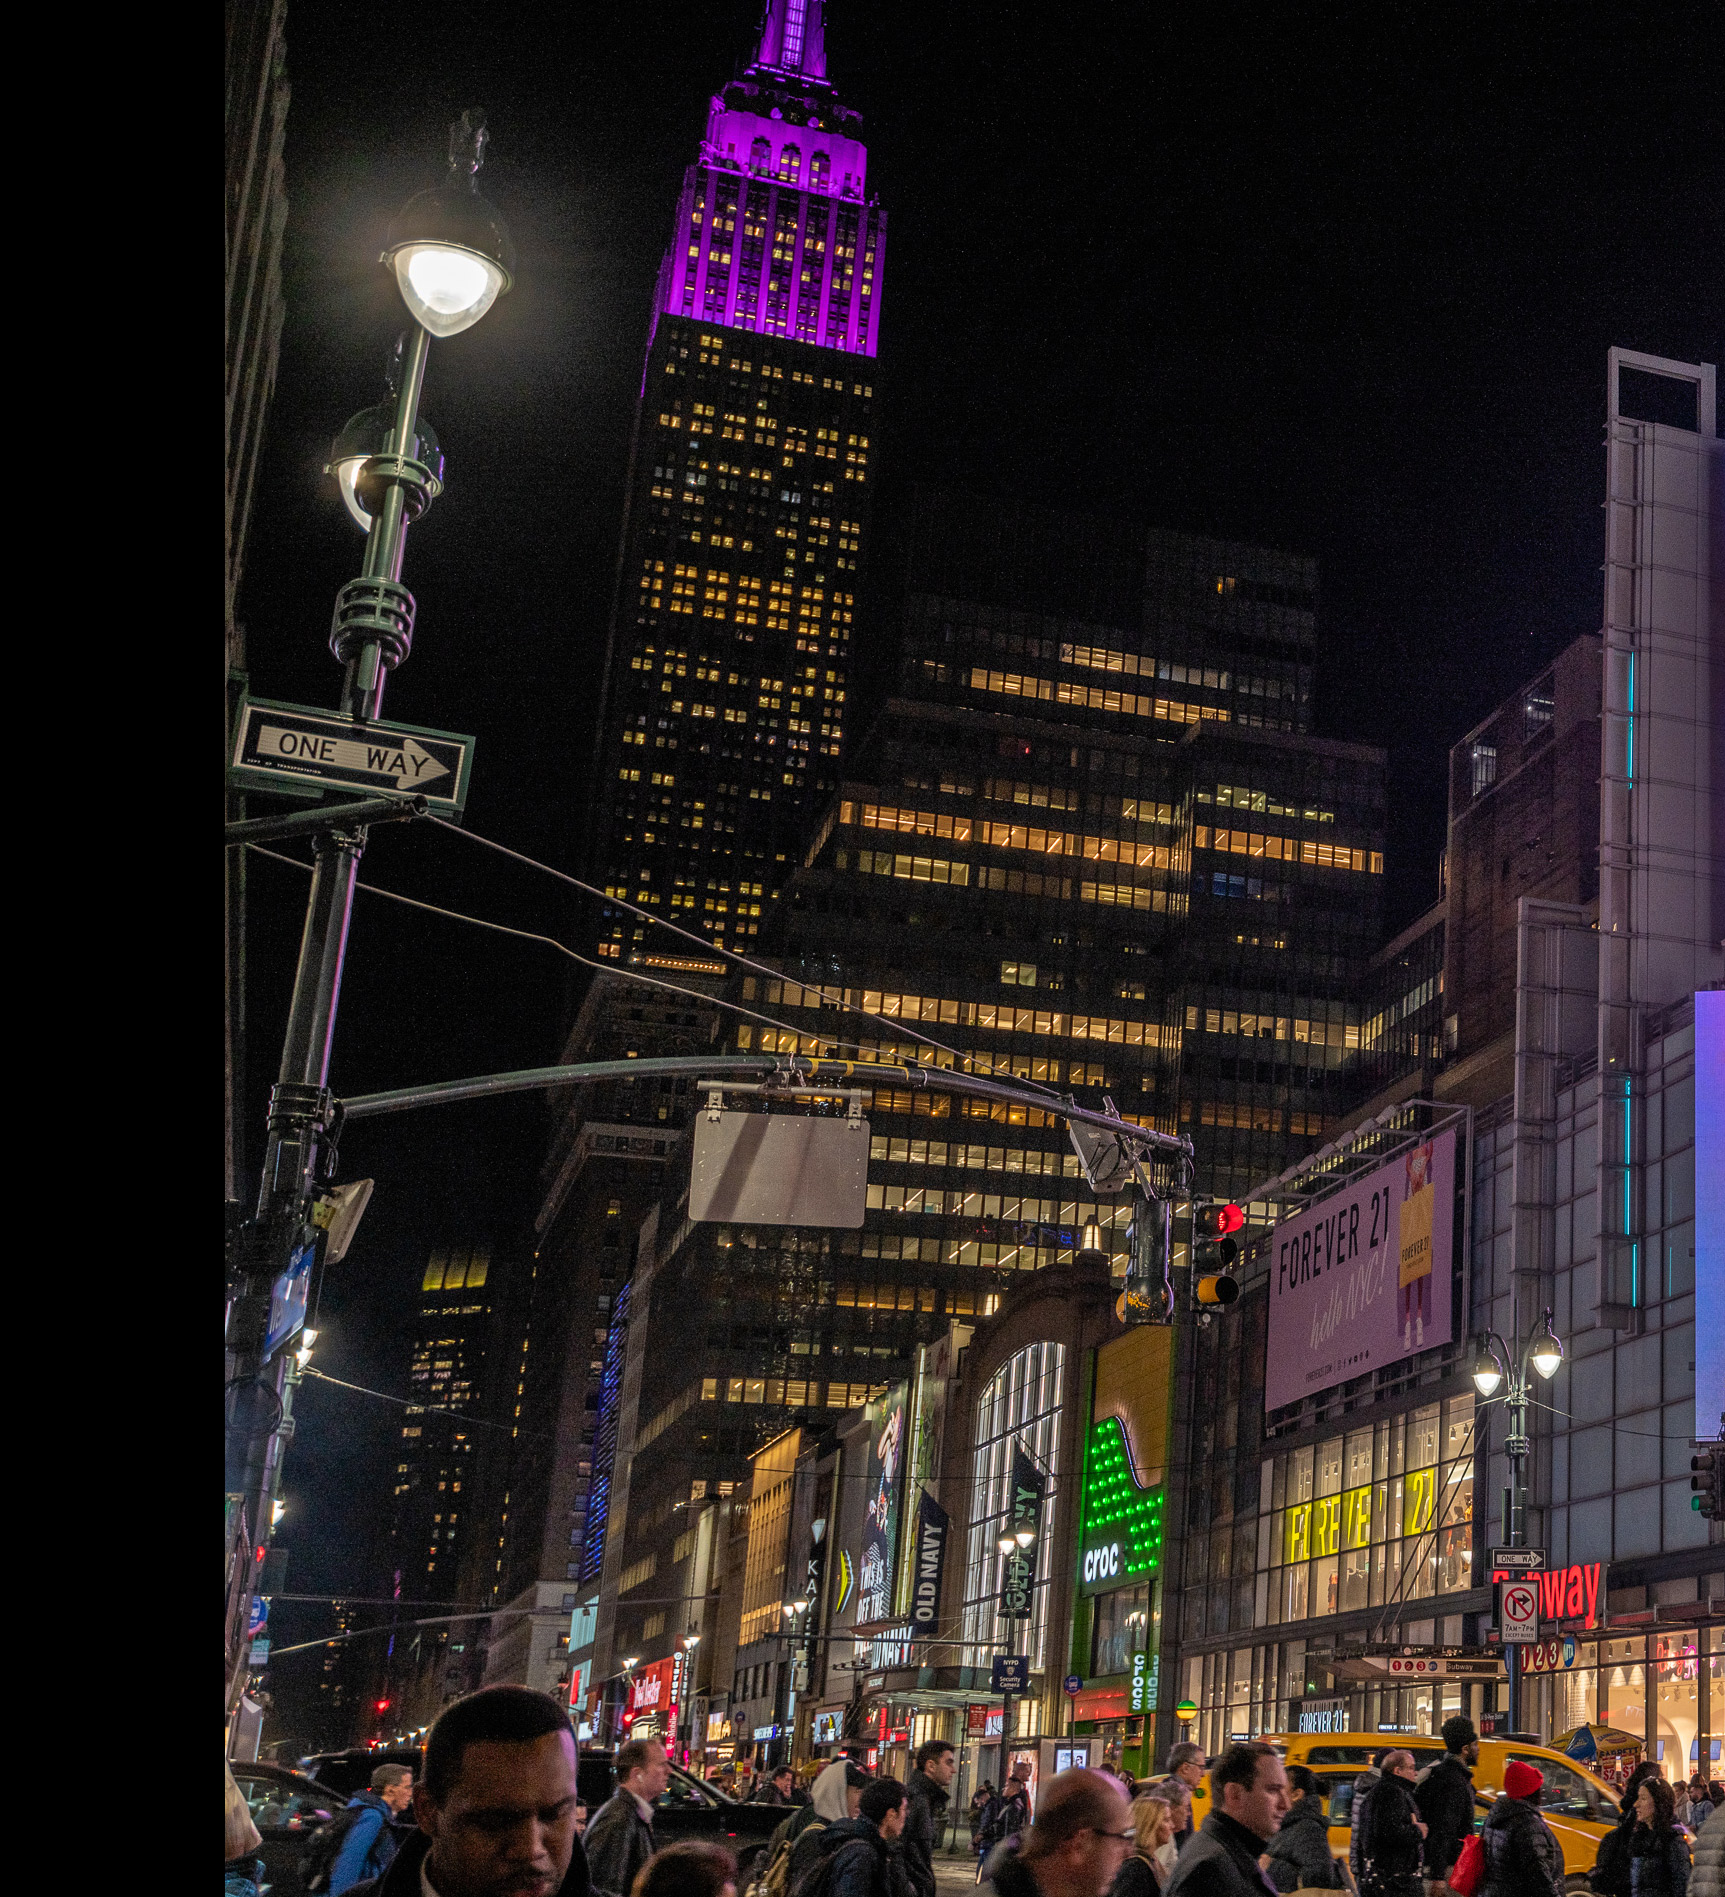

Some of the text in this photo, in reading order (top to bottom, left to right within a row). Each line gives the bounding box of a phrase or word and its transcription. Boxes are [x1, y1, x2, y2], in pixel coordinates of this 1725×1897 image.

[279, 733, 431, 777] ONE WAY
[1279, 1186, 1389, 1295] FOREVER 21
[1401, 1239, 1423, 1263] FOREVER
[1501, 1555, 1538, 1563] ONE WAY
[916, 1523, 943, 1621] OLD NAVY
[805, 1560, 818, 1612] KAY
[1505, 1624, 1535, 1632] 7AM-7PM
[1394, 1662, 1399, 1670] 1
[1447, 1661, 1474, 1671] Subway
[1536, 1644, 1542, 1666] 2
[1549, 1642, 1557, 1664] 3
[1132, 1654, 1144, 1710] crocs
[1300, 1710, 1343, 1733] FOREVER 21
[1604, 1769, 1615, 1781] $2
